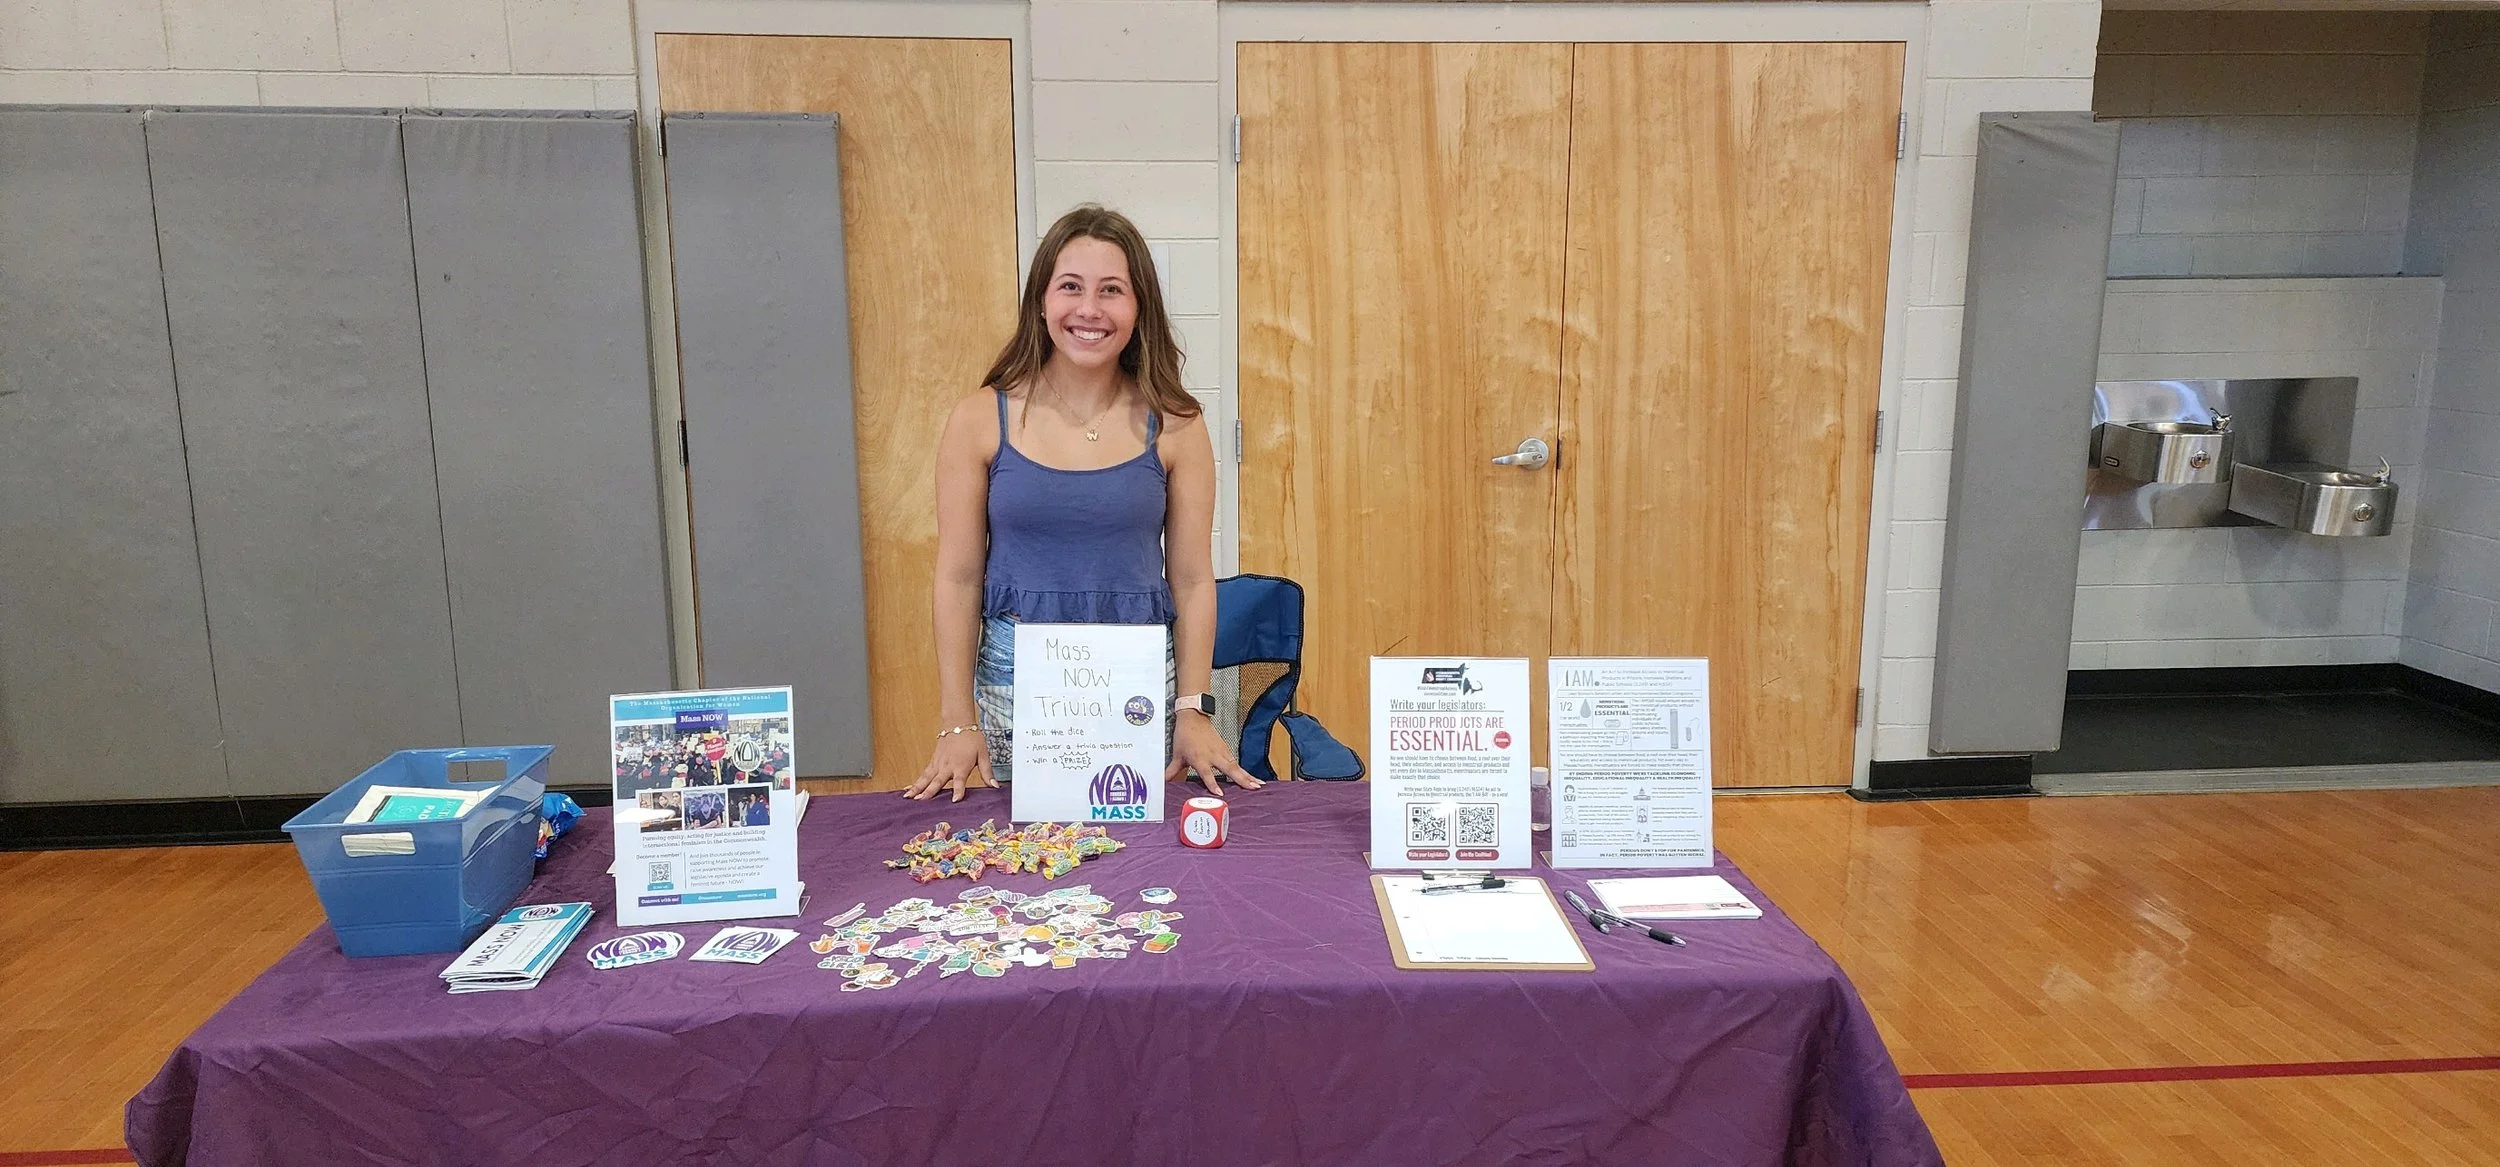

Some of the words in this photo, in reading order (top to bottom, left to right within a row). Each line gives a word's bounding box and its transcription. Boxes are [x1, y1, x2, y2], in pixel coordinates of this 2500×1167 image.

[1046, 638, 1091, 661] Mass
[1064, 668, 1111, 688] NOW
[1034, 693, 1112, 718] Trivia!
[1390, 700, 1415, 709] Write
[1417, 701, 1436, 711] your
[1438, 699, 1486, 711] legislators:
[680, 715, 700, 723] Mass
[701, 713, 724, 721] NOW
[1390, 717, 1426, 728] PERIOD
[1485, 717, 1504, 728] ARE
[1031, 728, 1046, 736] Roll
[1050, 728, 1064, 736] the
[1068, 727, 1085, 736] dice
[1032, 743, 1062, 751] Answer
[1099, 743, 1134, 751] question
[1390, 730, 1488, 751] ESSENTIAL.
[1064, 757, 1088, 765] PRIZE
[418, 804, 437, 819] PAD
[1092, 805, 1146, 820] MASS
[466, 944, 503, 967] MASS
[496, 924, 526, 943] NOW
[597, 949, 668, 967] MASS
[705, 948, 763, 960] MASS
